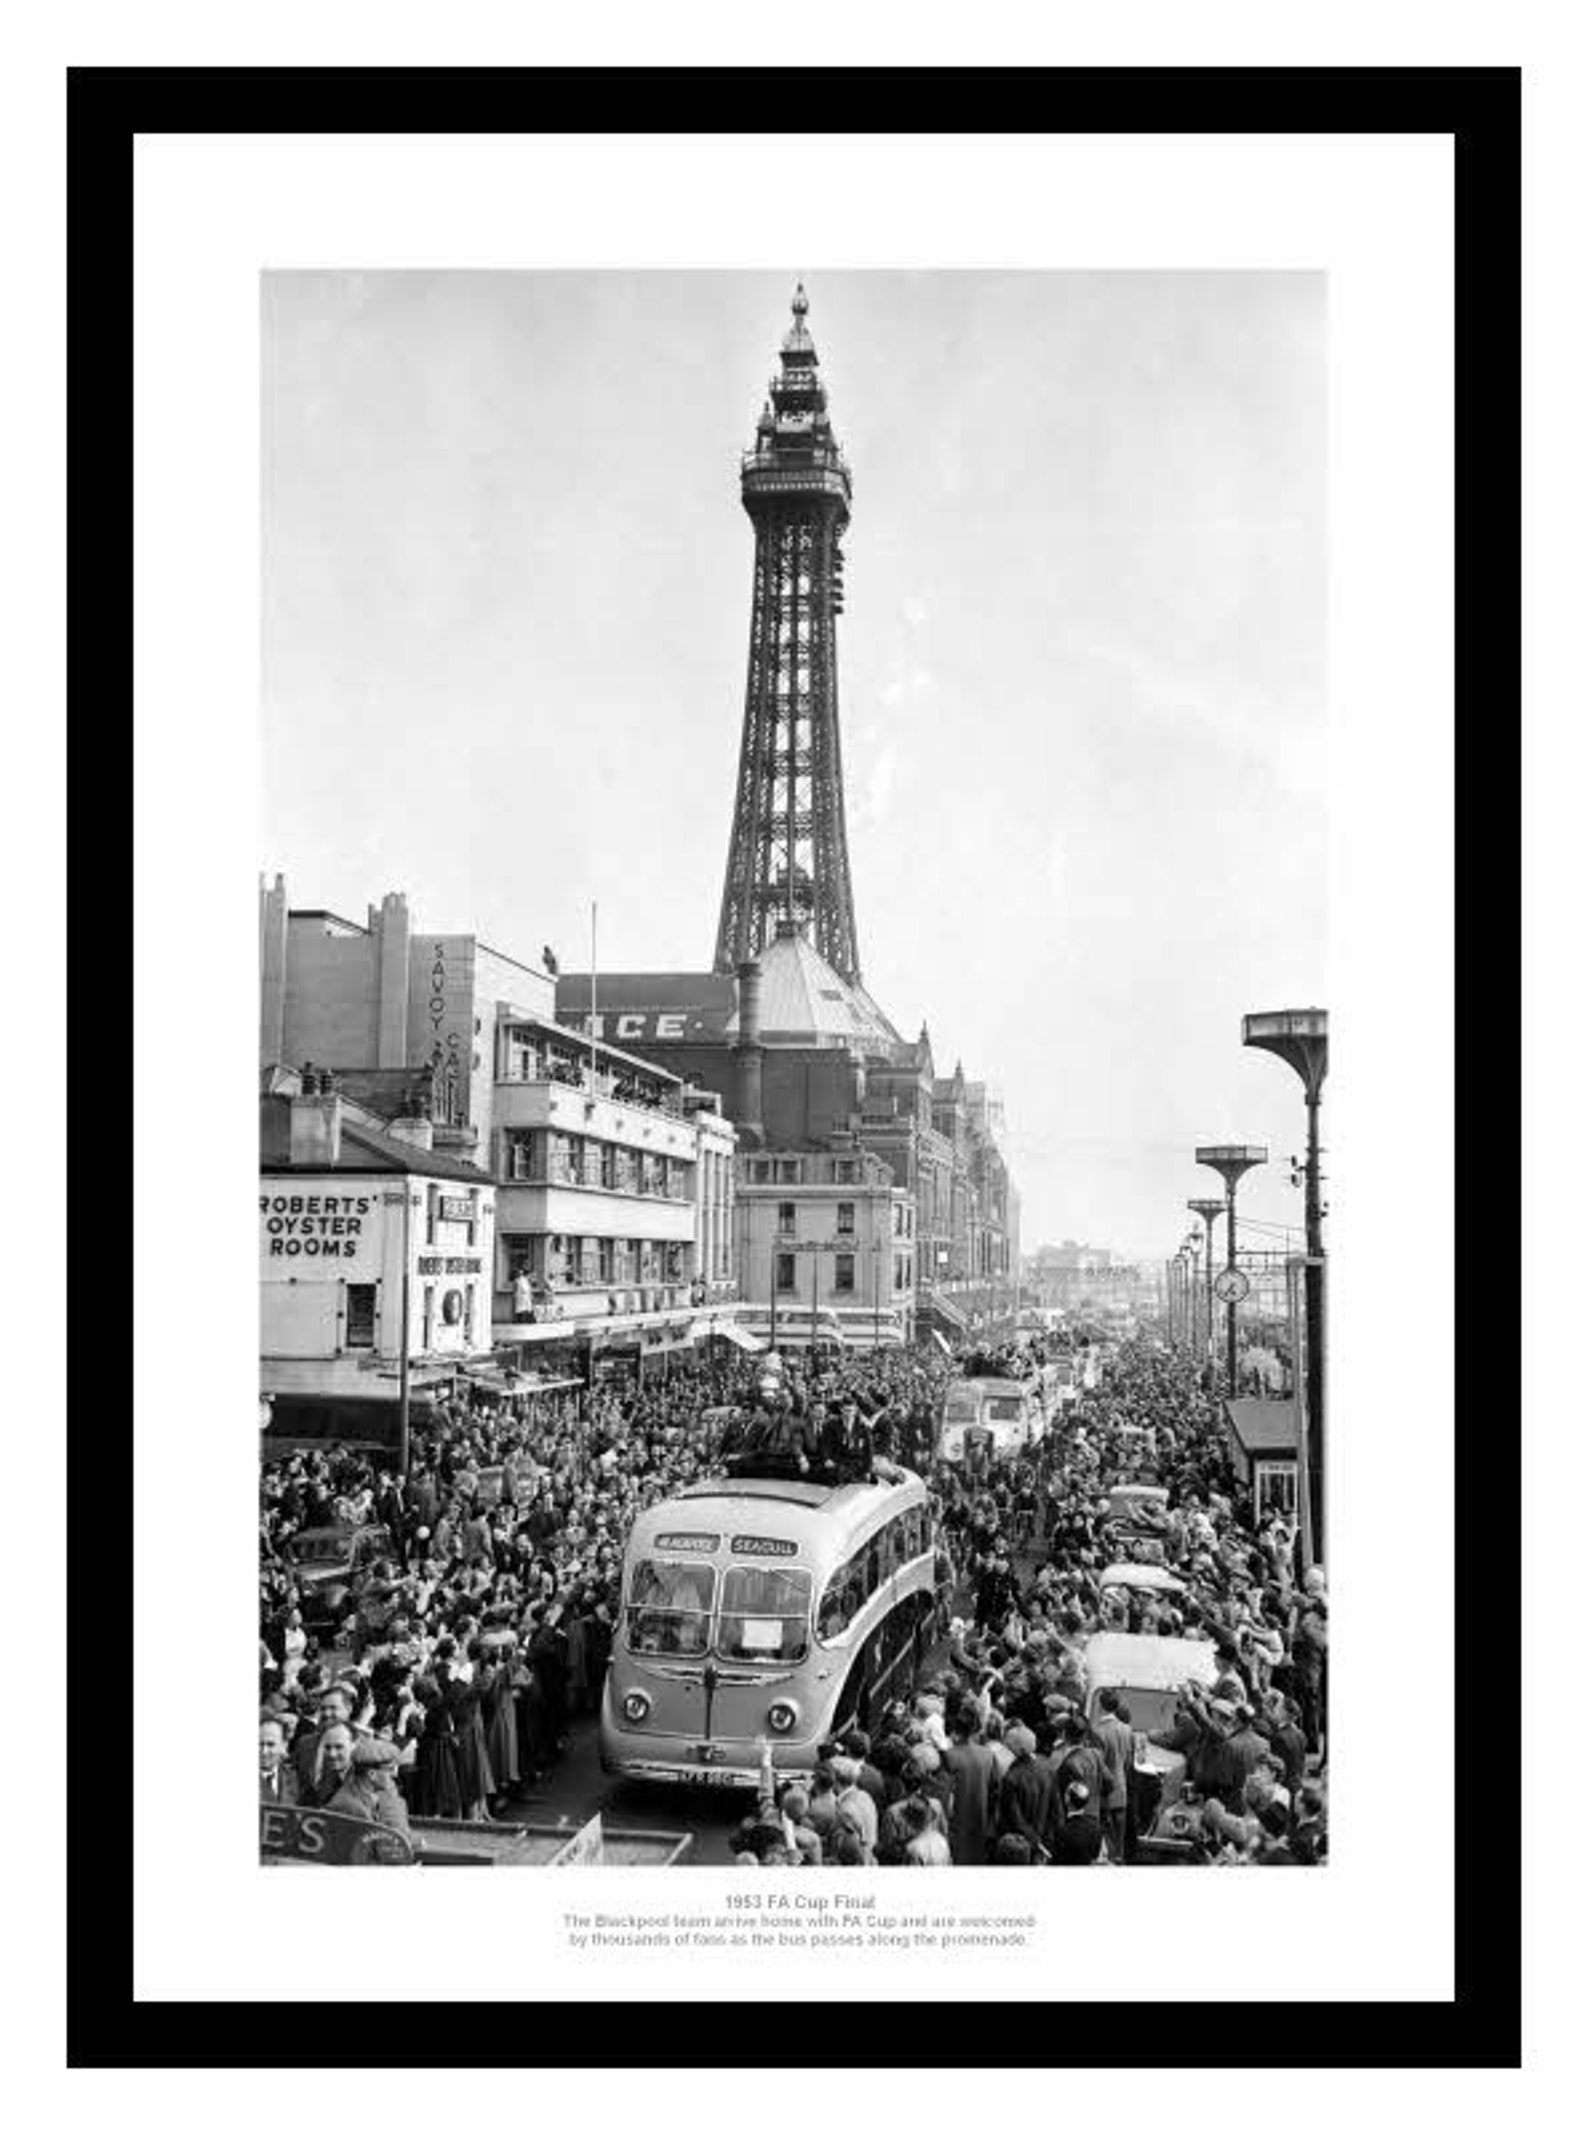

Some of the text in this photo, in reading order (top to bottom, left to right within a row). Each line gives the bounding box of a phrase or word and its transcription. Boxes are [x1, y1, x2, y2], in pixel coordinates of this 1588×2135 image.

[428, 943, 446, 1031] SAVOY
[266, 1217, 362, 1236] OYSTER
[269, 1238, 356, 1258] ROOMS
[733, 1537, 795, 1556] SEAGULL
